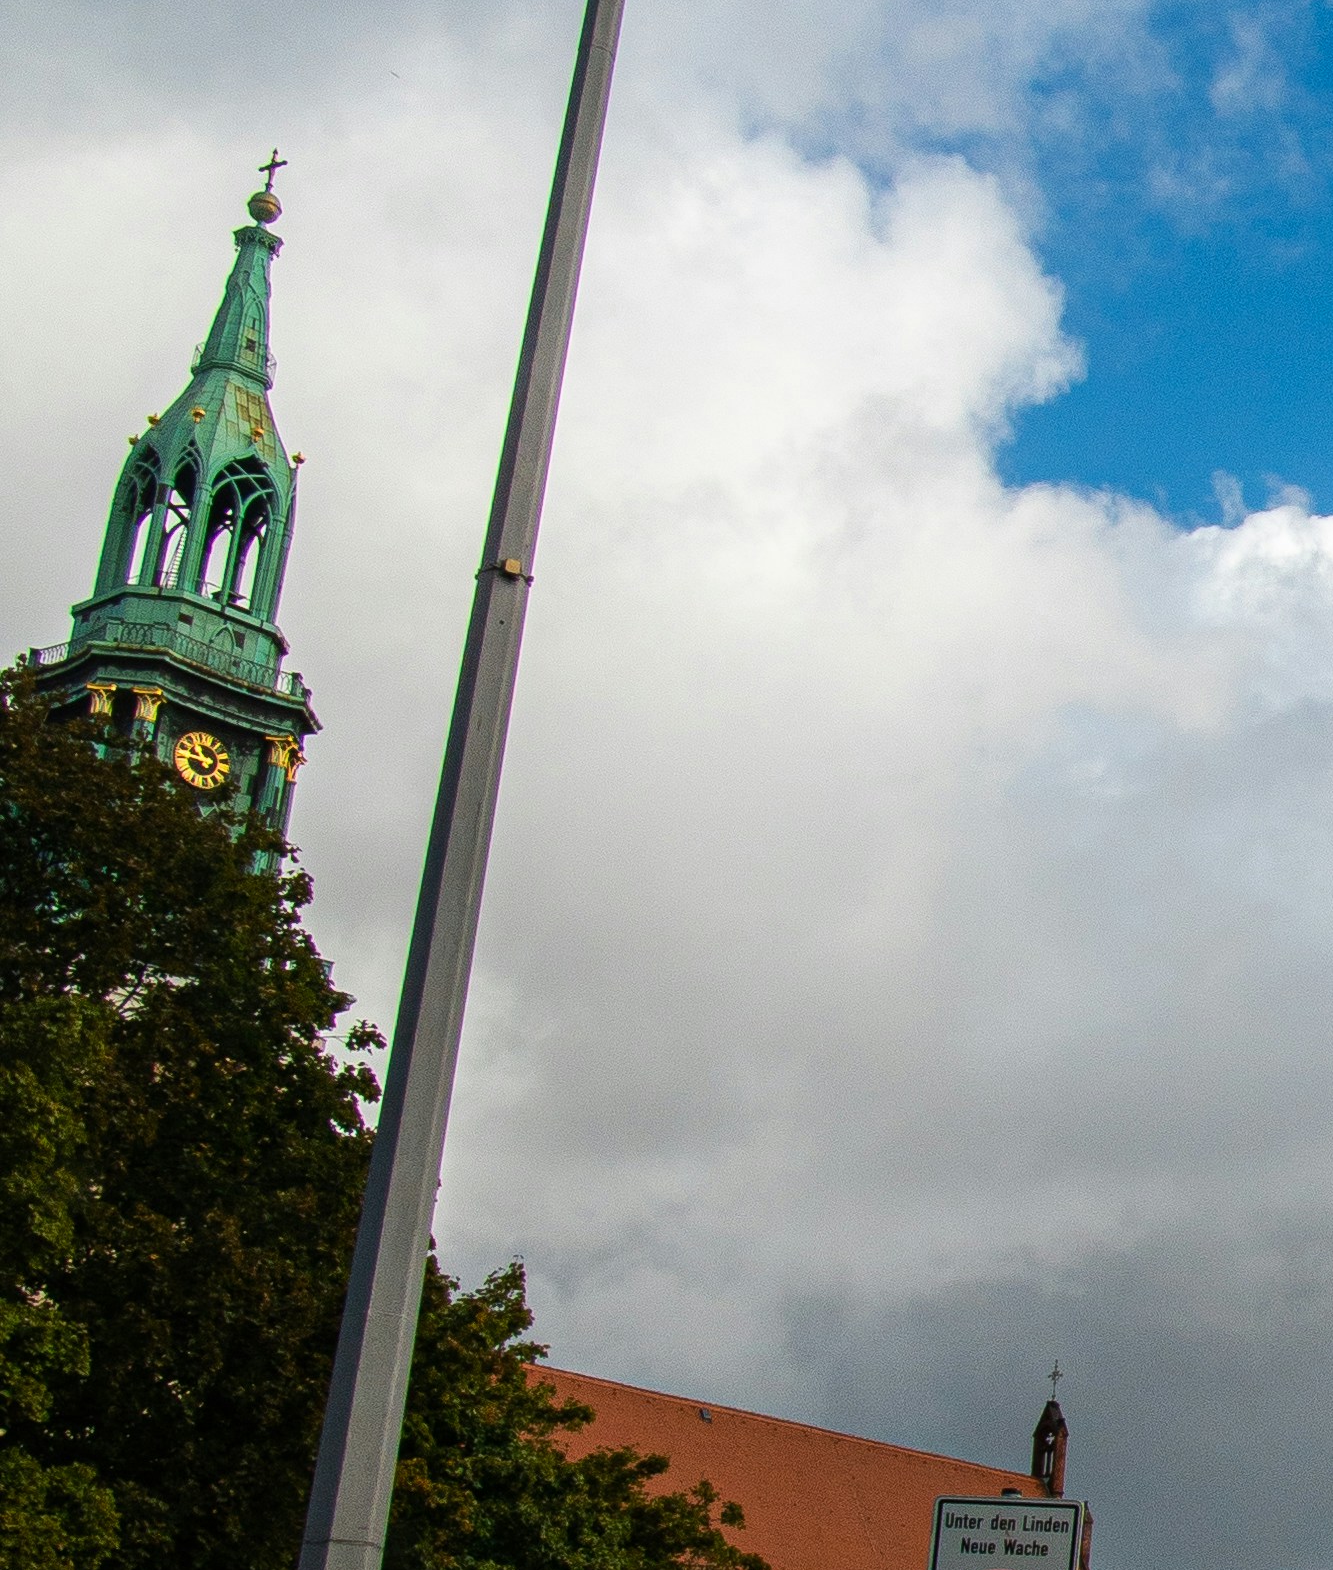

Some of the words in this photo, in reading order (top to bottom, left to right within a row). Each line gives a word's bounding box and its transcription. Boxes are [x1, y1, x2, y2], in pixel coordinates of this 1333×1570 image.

[945, 1512, 984, 1530] Unter
[990, 1514, 1016, 1532] den
[1022, 1515, 1069, 1534] Linden
[960, 1537, 996, 1555] Neue
[1003, 1538, 1049, 1557] Wache
